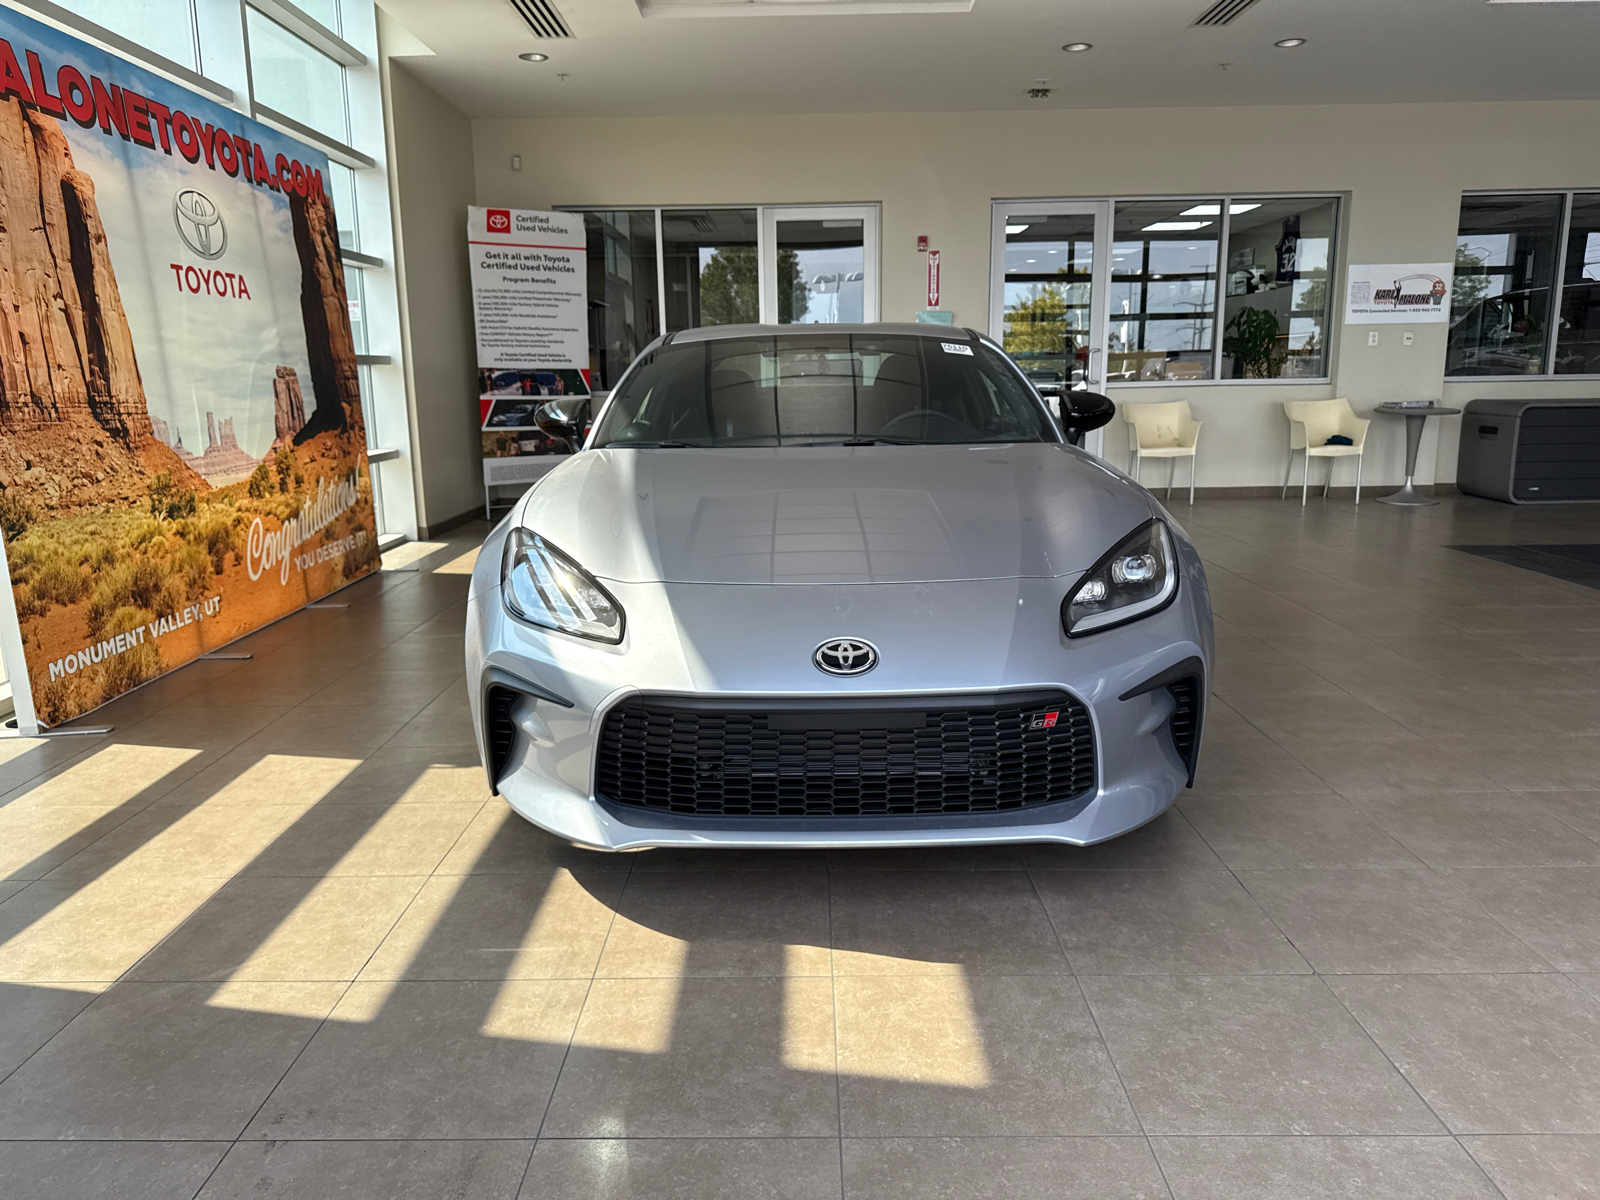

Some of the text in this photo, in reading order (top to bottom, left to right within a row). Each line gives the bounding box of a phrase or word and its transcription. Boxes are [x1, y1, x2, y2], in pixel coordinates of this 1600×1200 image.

[0, 38, 325, 204] ALONETOYOTA.COM
[516, 215, 549, 224] Certified
[516, 224, 568, 234] Used Vehicles
[485, 252, 501, 260] Get
[502, 252, 509, 260] it
[543, 255, 570, 264] Toyota
[481, 262, 518, 270] Certified
[542, 264, 575, 273] Vehicles
[170, 263, 251, 300] TOYOTA
[502, 276, 530, 284] Program
[1399, 294, 1430, 304] MALONE
[247, 453, 361, 585] Congratulations!
[294, 530, 367, 572] YOU DESERVE IT!
[48, 596, 221, 682] MONUMENT VALLEY, UT
[1032, 718, 1056, 728] GR
